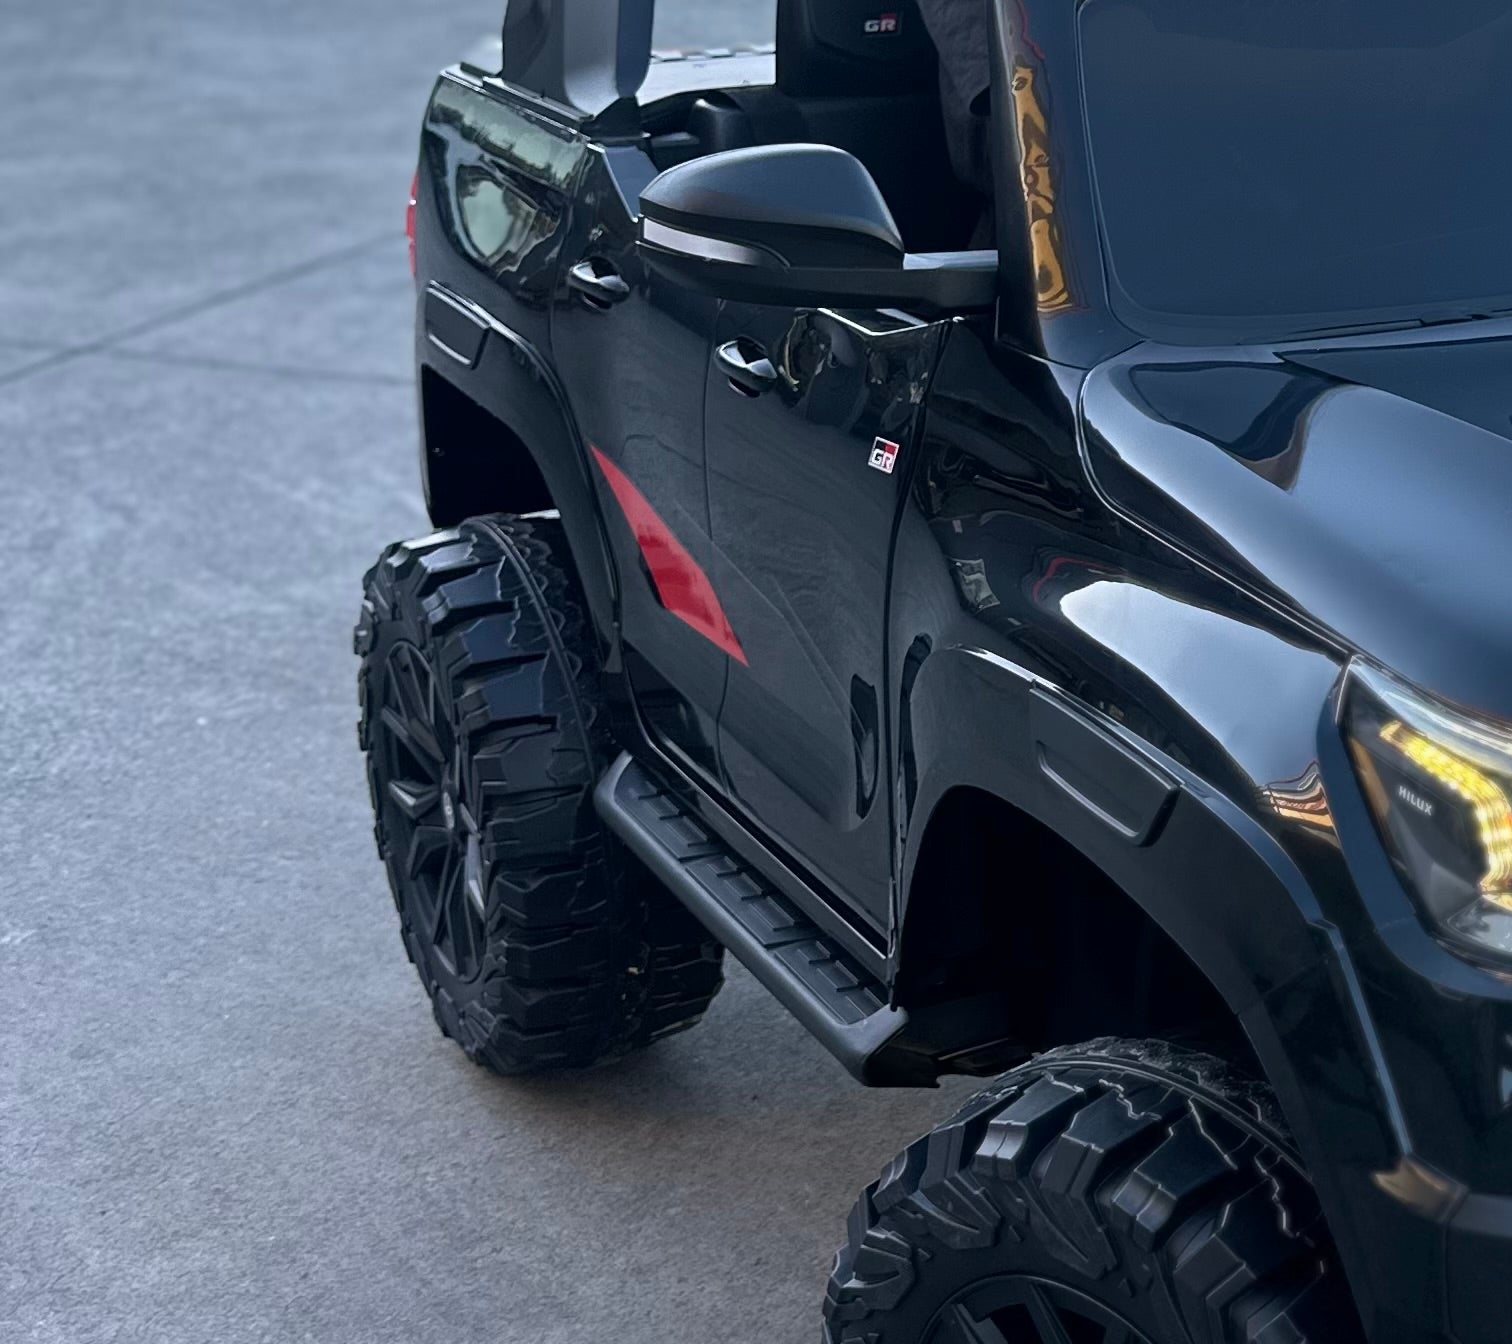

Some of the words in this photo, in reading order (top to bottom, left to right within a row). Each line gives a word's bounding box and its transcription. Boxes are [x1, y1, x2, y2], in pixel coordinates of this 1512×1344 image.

[864, 18, 897, 32] GR
[870, 446, 895, 472] GR
[1398, 785, 1432, 816] HILUX
